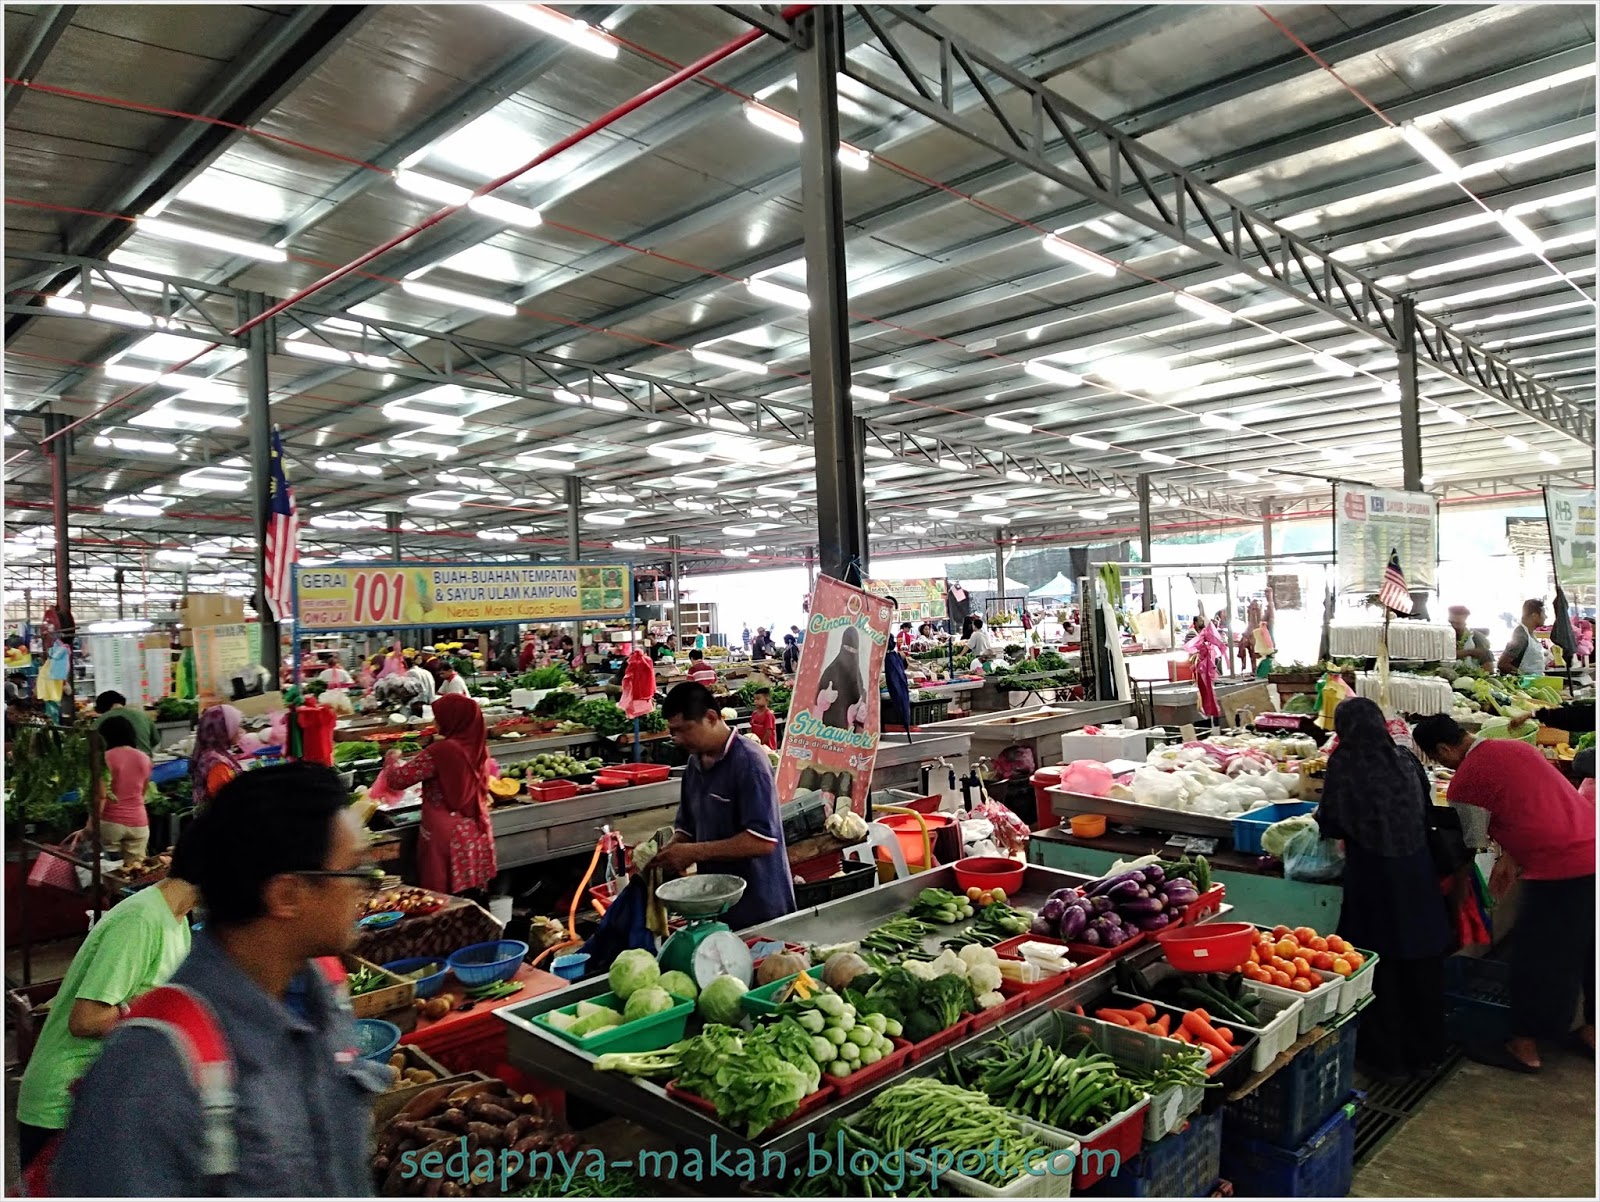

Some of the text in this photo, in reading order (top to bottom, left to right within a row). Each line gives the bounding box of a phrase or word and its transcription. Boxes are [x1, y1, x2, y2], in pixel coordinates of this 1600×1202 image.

[302, 573, 347, 589] GERAI
[433, 569, 577, 585] BUAH-BUAHAN TEMPATAN
[354, 572, 404, 622] 101
[435, 585, 578, 601] & SAYUR ULAM KAMPUNG
[810, 613, 852, 633] Cincau
[789, 711, 877, 748] Strawberi
[789, 736, 808, 746] Sedia
[811, 739, 820, 747] di
[821, 743, 844, 753] makan
